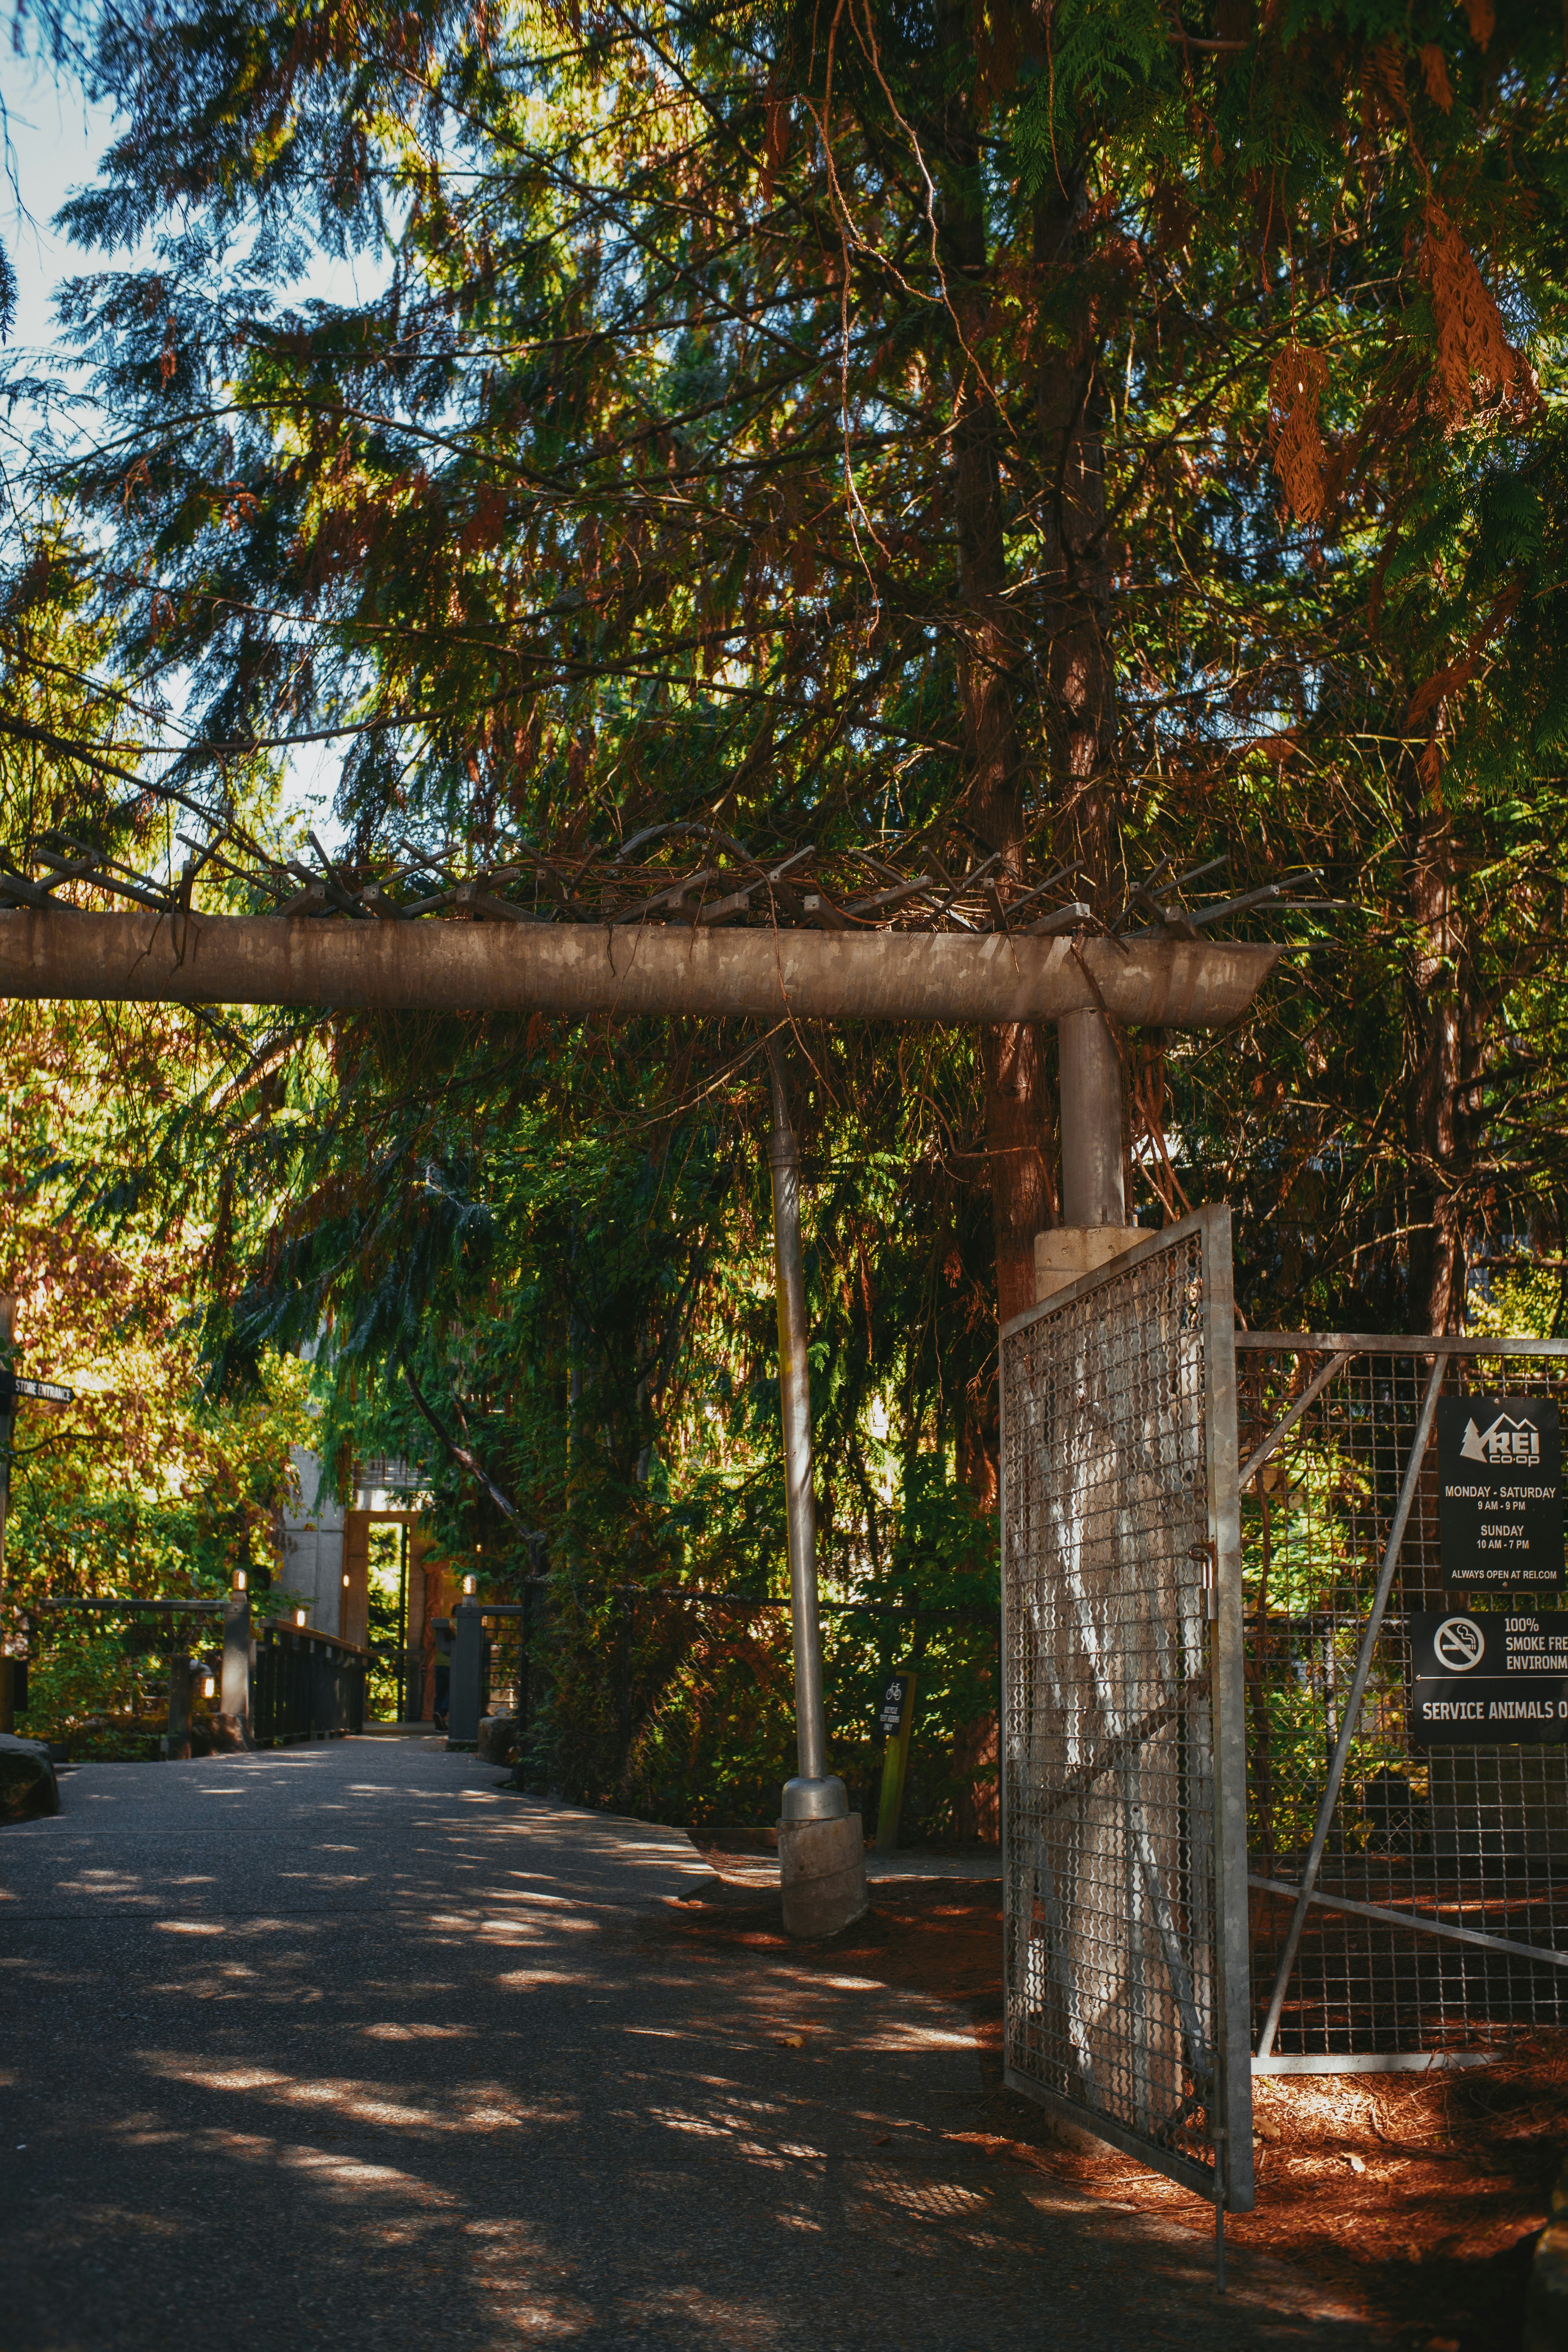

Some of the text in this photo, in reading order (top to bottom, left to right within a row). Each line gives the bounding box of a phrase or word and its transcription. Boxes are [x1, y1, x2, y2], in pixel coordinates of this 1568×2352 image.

[15, 1379, 70, 1401] STORE ENTRANCE
[1489, 1432, 1540, 1454] REI
[1445, 1486, 1491, 1497] MONDAY
[1500, 1487, 1556, 1498] SATURDAY
[1478, 1501, 1483, 1510] 9
[1484, 1501, 1498, 1510] AM
[1505, 1502, 1511, 1510] 9
[1513, 1502, 1525, 1510] PM
[1481, 1525, 1524, 1536] SUNDAY
[1477, 1540, 1486, 1549] 10
[1488, 1540, 1501, 1549] AM
[1509, 1540, 1514, 1549] 7
[1516, 1540, 1529, 1549] PM
[1451, 1570, 1557, 1580] ALWAYS OPEN AT REI.COM
[1505, 1617, 1539, 1632] 100%
[1506, 1636, 1546, 1651] SMOKE
[1423, 1702, 1484, 1720] SERVICE
[1489, 1701, 1554, 1719] ANIMALS
